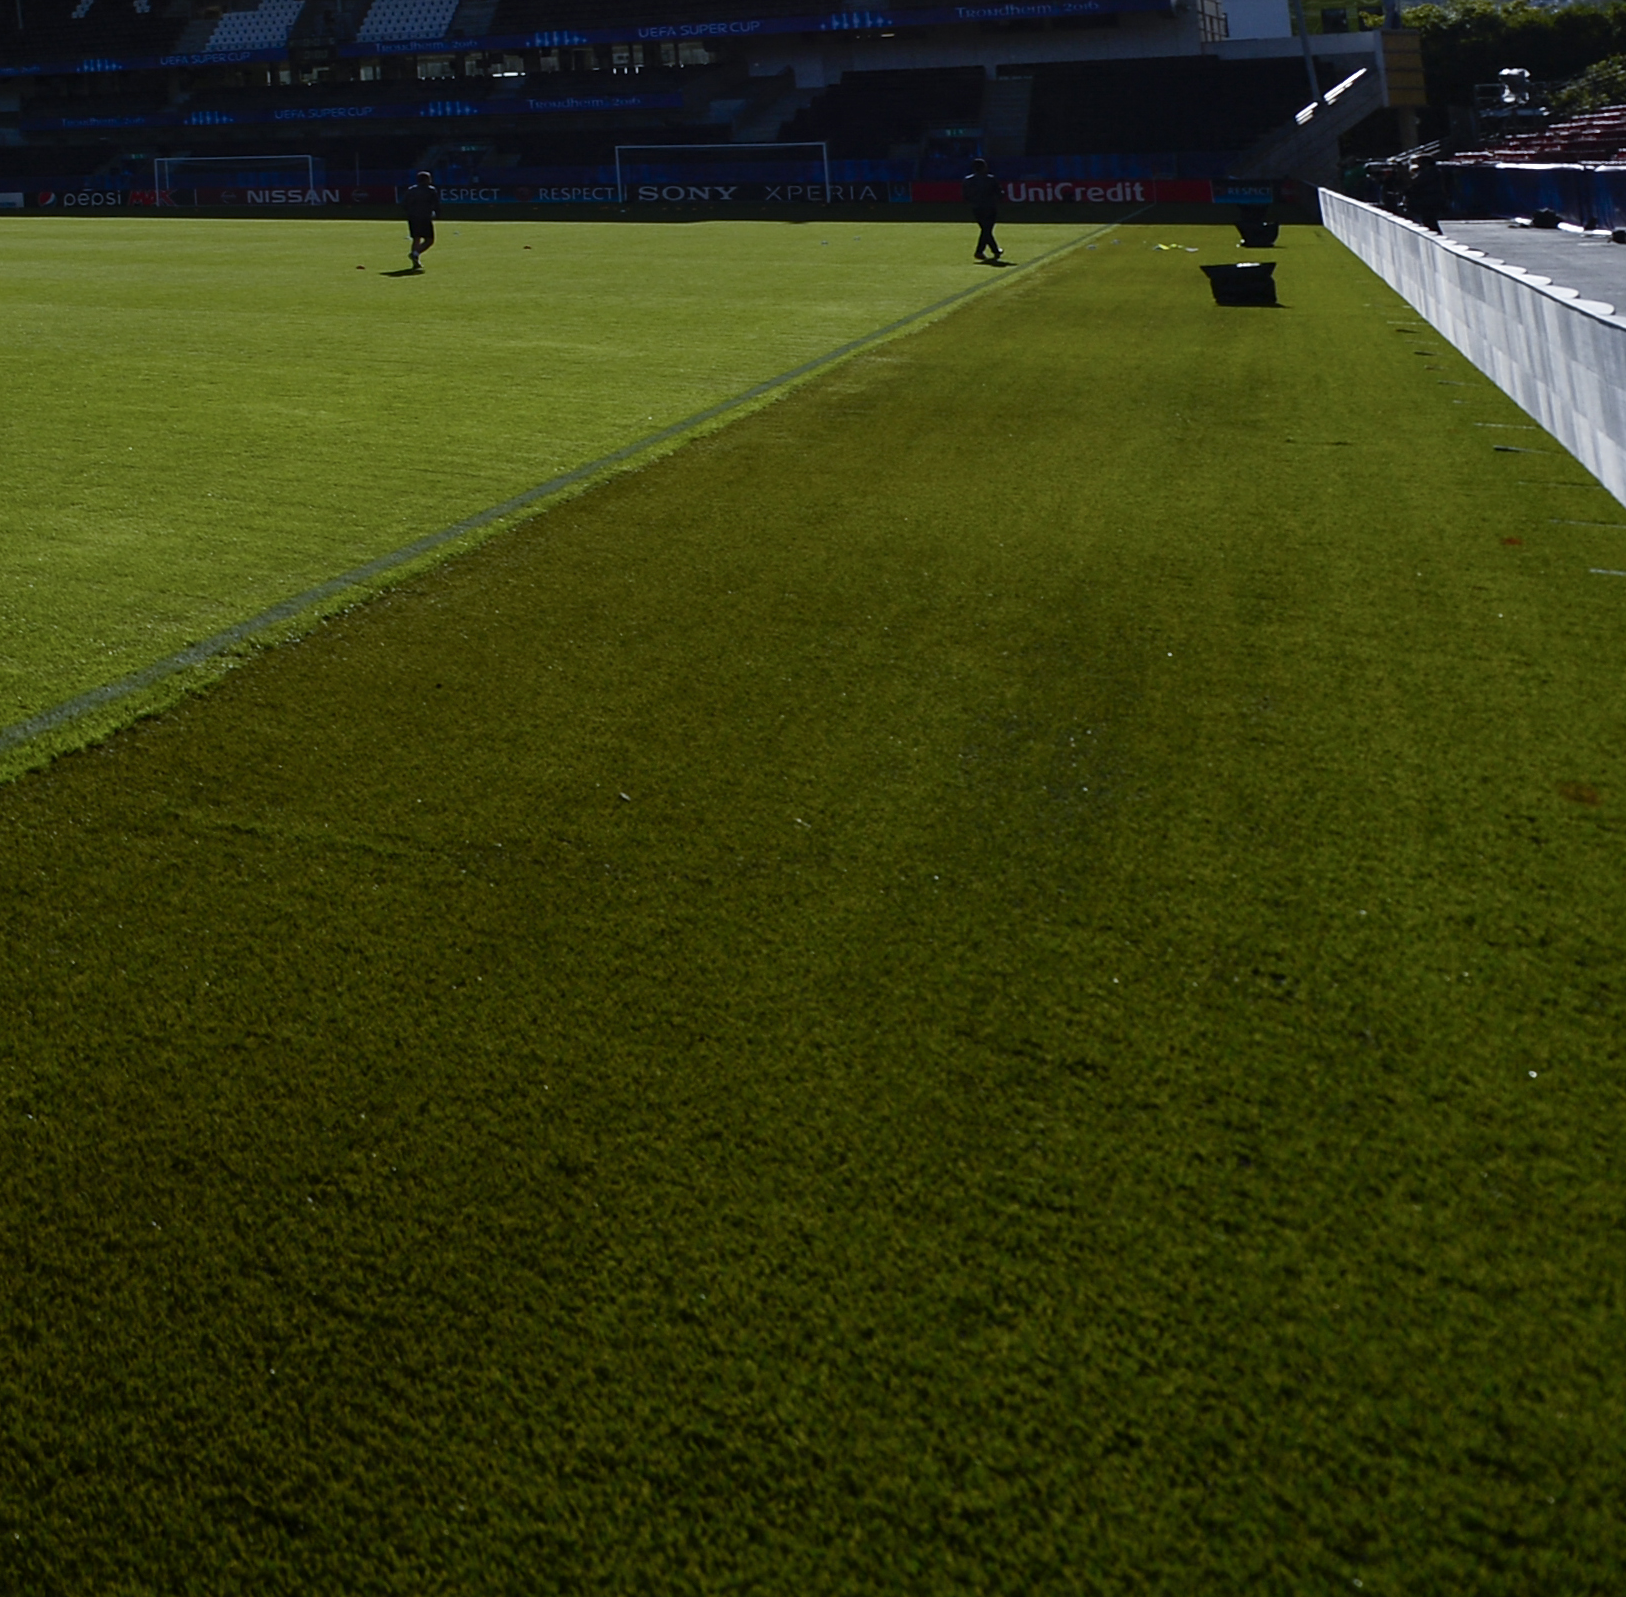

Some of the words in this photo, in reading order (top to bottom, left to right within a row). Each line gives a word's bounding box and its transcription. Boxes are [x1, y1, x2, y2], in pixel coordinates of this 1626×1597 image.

[1063, 0, 1099, 13] 2016
[638, 26, 677, 39] UEFA
[679, 23, 728, 37] SUPER
[729, 20, 761, 33] CUP
[160, 55, 189, 66] UEFA
[190, 53, 226, 65] SUPER
[227, 52, 250, 62] CUP
[274, 109, 305, 120] UEFA
[307, 107, 346, 119] SUPER
[347, 106, 373, 118] CUP
[63, 188, 122, 207] pepsi
[247, 188, 340, 203] NISSAN
[440, 188, 501, 201] ESPECT
[539, 187, 616, 201] RESPECT
[638, 185, 738, 201] SONY
[765, 185, 878, 201] XPERIA
[1006, 182, 1145, 203] UniCredit
